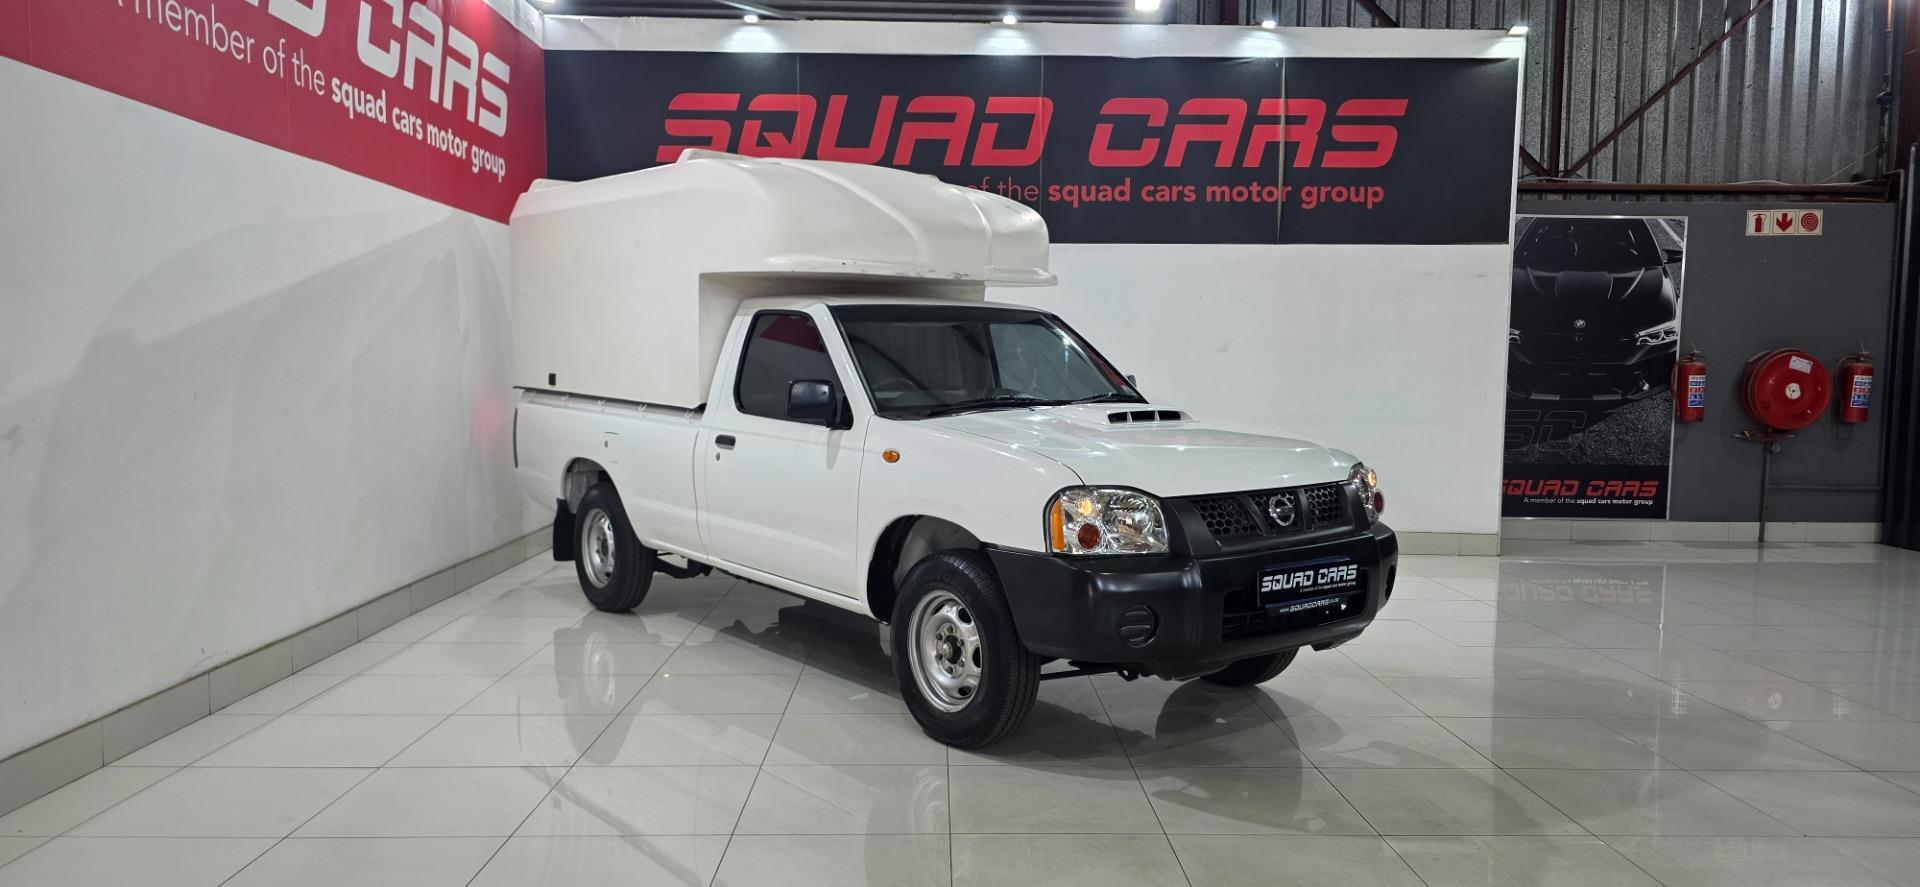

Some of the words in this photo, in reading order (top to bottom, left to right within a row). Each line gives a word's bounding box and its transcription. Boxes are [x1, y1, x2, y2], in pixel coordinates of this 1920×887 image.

[357, 0, 511, 137] CARS
[262, 38, 286, 78] of
[292, 48, 325, 96] the
[331, 77, 387, 124] squad
[392, 106, 423, 140] cars
[426, 123, 468, 160] motor
[471, 145, 506, 183] group
[655, 92, 1054, 168] SQUAD
[1088, 97, 1410, 168] CARS
[996, 176, 1040, 202] the
[1048, 177, 1131, 208] squad
[1140, 183, 1197, 203] cars
[1205, 180, 1292, 203] motor
[1300, 183, 1385, 209] group
[1576, 498, 1597, 506] squad
[1586, 480, 1660, 497] CARS
[1261, 570, 1314, 592] SQUAD
[1317, 564, 1358, 584] CARS
